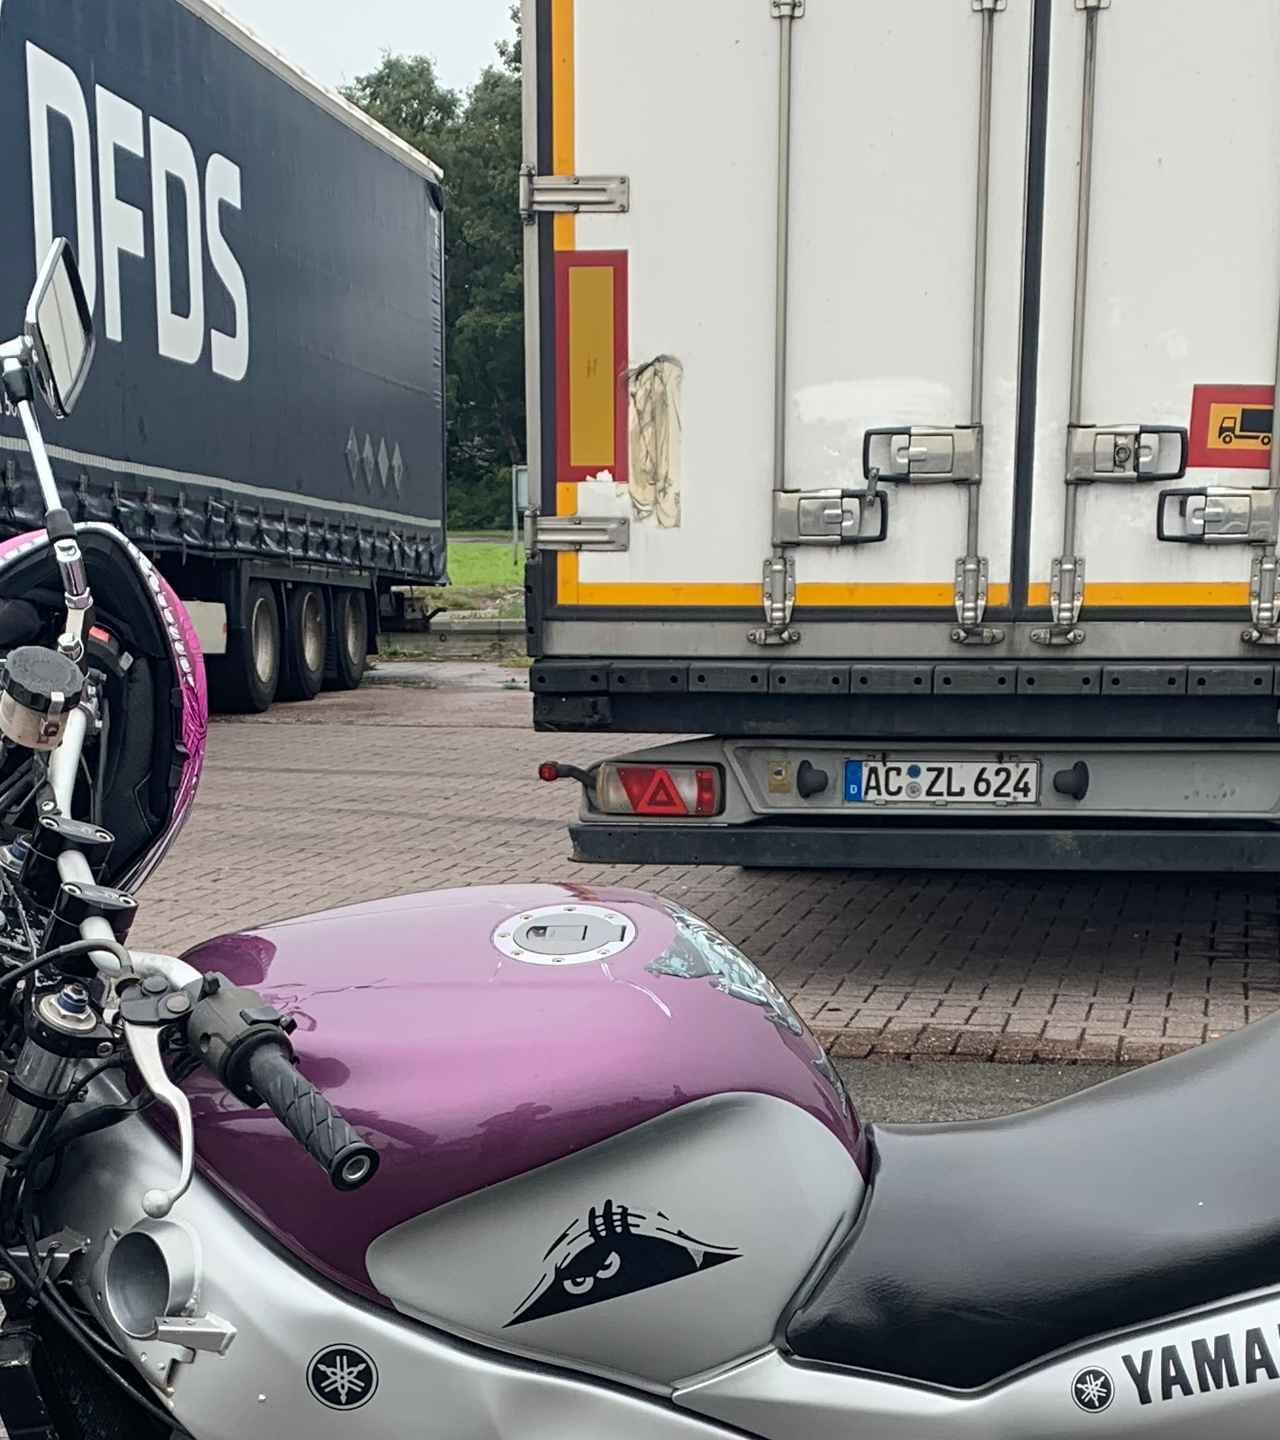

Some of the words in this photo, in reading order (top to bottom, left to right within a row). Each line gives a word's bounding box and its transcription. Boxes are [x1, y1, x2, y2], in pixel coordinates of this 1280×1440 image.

[26, 39, 249, 381] DFDS
[864, 766, 903, 797] AC
[925, 767, 966, 798] ZL
[973, 766, 1032, 799] 624
